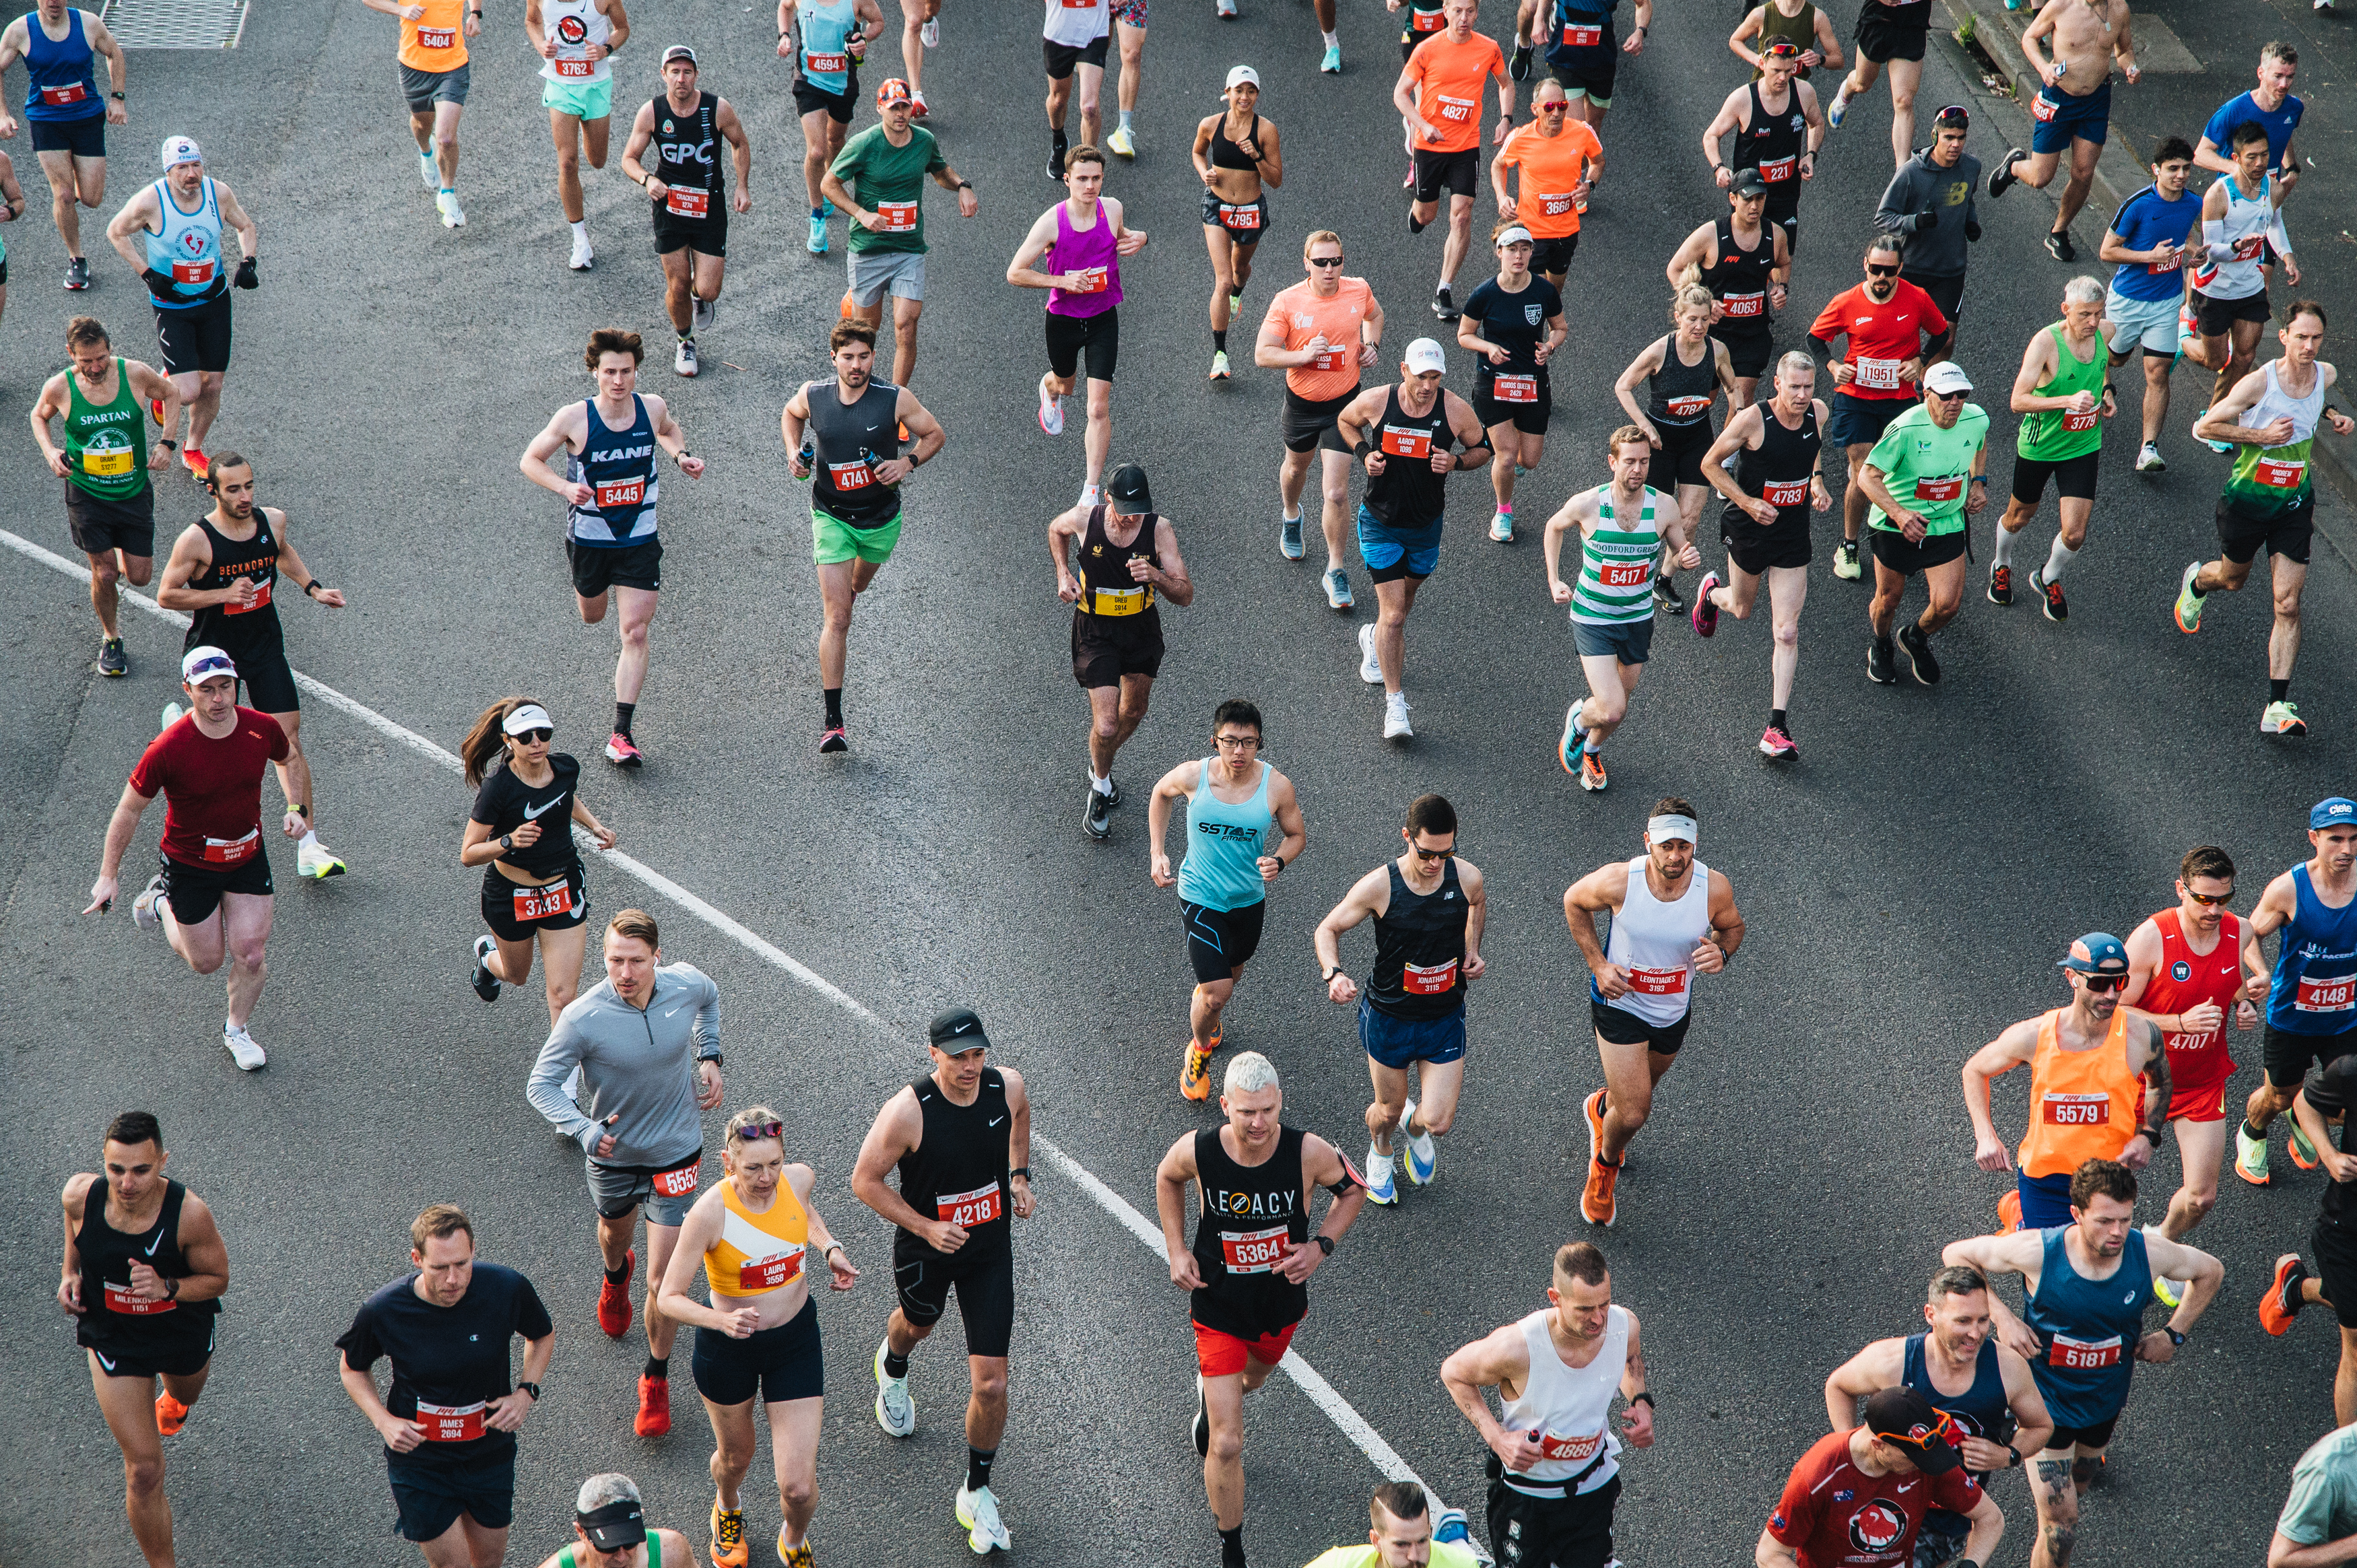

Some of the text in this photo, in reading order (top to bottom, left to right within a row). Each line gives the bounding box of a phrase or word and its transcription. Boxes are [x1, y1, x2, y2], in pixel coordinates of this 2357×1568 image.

[424, 34, 449, 47] 5404
[562, 63, 587, 75] 3762
[814, 59, 839, 71] 4594
[1442, 104, 1467, 121] 4827
[661, 141, 714, 164] GPC
[1770, 165, 1788, 180] 221
[676, 193, 699, 203] CRACKERS
[1546, 200, 1570, 214] 3666
[1227, 213, 1252, 226] 4795
[176, 225, 213, 244] TERRIGAL TROTTERS
[1730, 301, 1756, 314] 4063
[1864, 366, 1892, 381] 11951
[81, 411, 131, 425] SPARTAN
[2071, 413, 2096, 430] 3779
[1397, 437, 1416, 446] AARON
[591, 445, 652, 463] KANE
[1399, 446, 1412, 454] 1099
[841, 469, 869, 487] 4741
[2271, 469, 2292, 477] ANDREW
[606, 486, 638, 504] 5445
[1772, 489, 1801, 504] 4783
[1591, 542, 1658, 554] WOODFORD GREE
[220, 556, 274, 576] BECKWORTH
[1609, 570, 1640, 584] 5417
[2329, 804, 2352, 815] ciele
[224, 845, 244, 855] MAHER
[226, 853, 241, 861] 2444
[526, 894, 560, 916] 3743
[1417, 974, 1447, 984] JONATHAN
[1640, 974, 1675, 985] LEONTIADES
[1425, 984, 1440, 992] 3115
[1649, 984, 1665, 992] 3193
[2310, 986, 2347, 1004] 4148
[2169, 1032, 2209, 1050] 4707
[2056, 1104, 2098, 1123] 5579
[665, 1165, 698, 1194] 5552
[952, 1199, 991, 1226] 4218
[1242, 1211, 1294, 1221] PERFORMANCE
[1235, 1242, 1280, 1264] 5364
[764, 1263, 786, 1276] LAURA
[766, 1274, 784, 1285] 3558
[2066, 1350, 2107, 1367] 5181
[439, 1419, 464, 1429] JAMES
[441, 1429, 462, 1438] 2694
[1550, 1440, 1595, 1458] 4888
